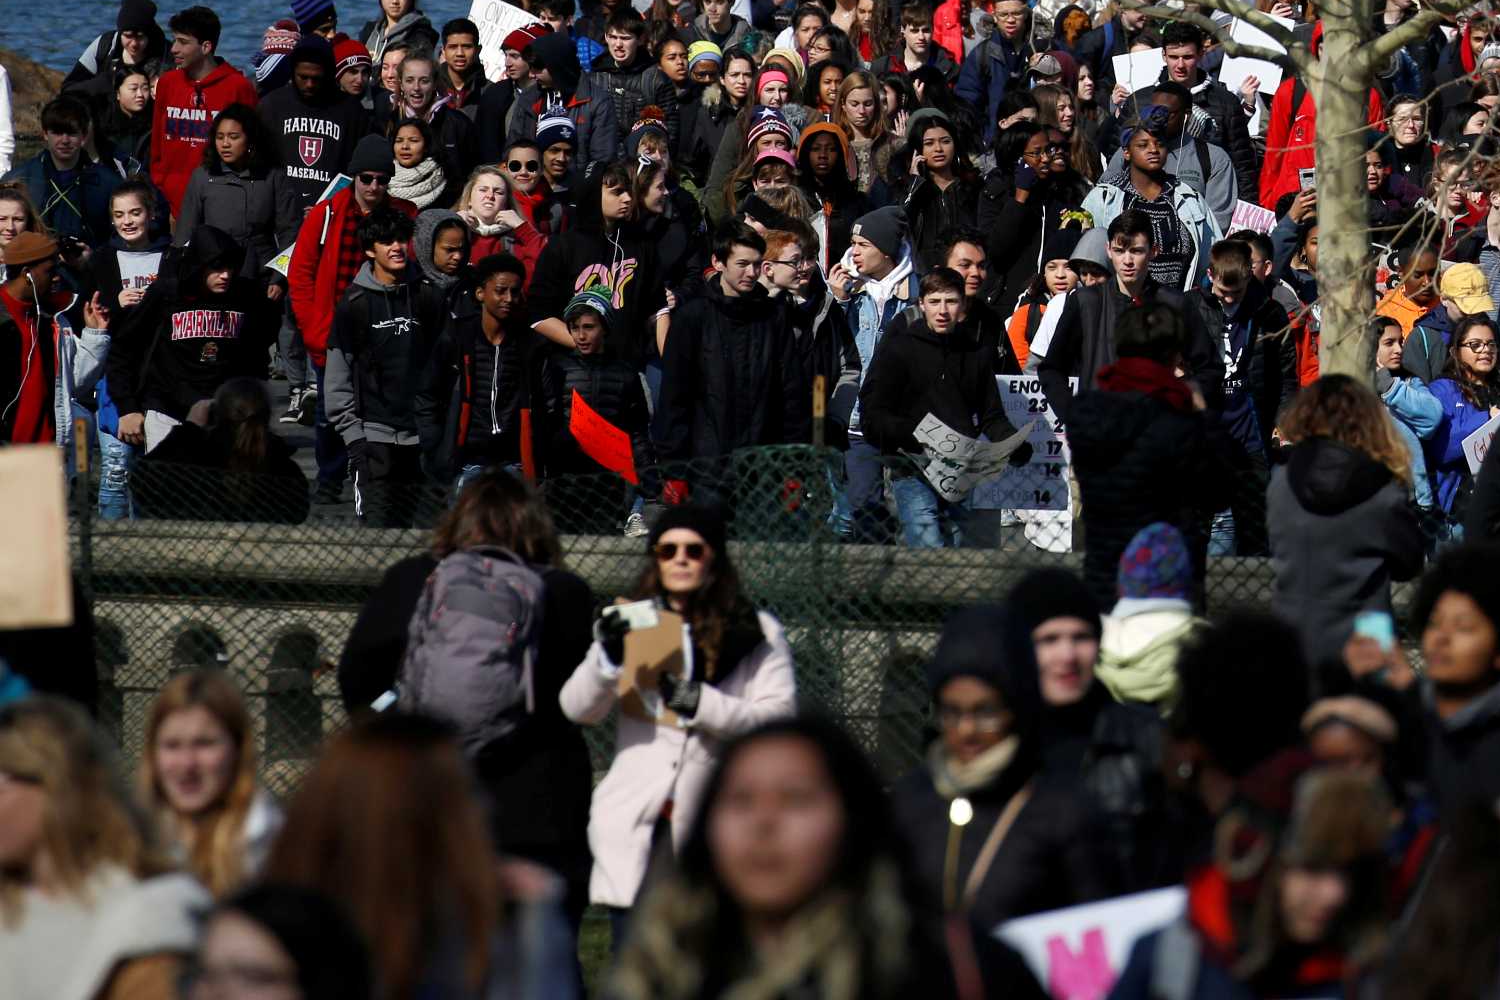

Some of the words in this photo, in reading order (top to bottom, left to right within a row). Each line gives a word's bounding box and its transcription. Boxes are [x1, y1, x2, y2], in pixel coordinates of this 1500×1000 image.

[166, 106, 206, 121] TRAIN
[284, 116, 340, 141] HARVARD
[304, 139, 316, 157] H
[287, 165, 331, 182] BASEBALL
[171, 309, 243, 341] MARYLAN
[1028, 399, 1048, 413] 23
[1047, 441, 1063, 455] 17
[1034, 489, 1051, 504] 14
